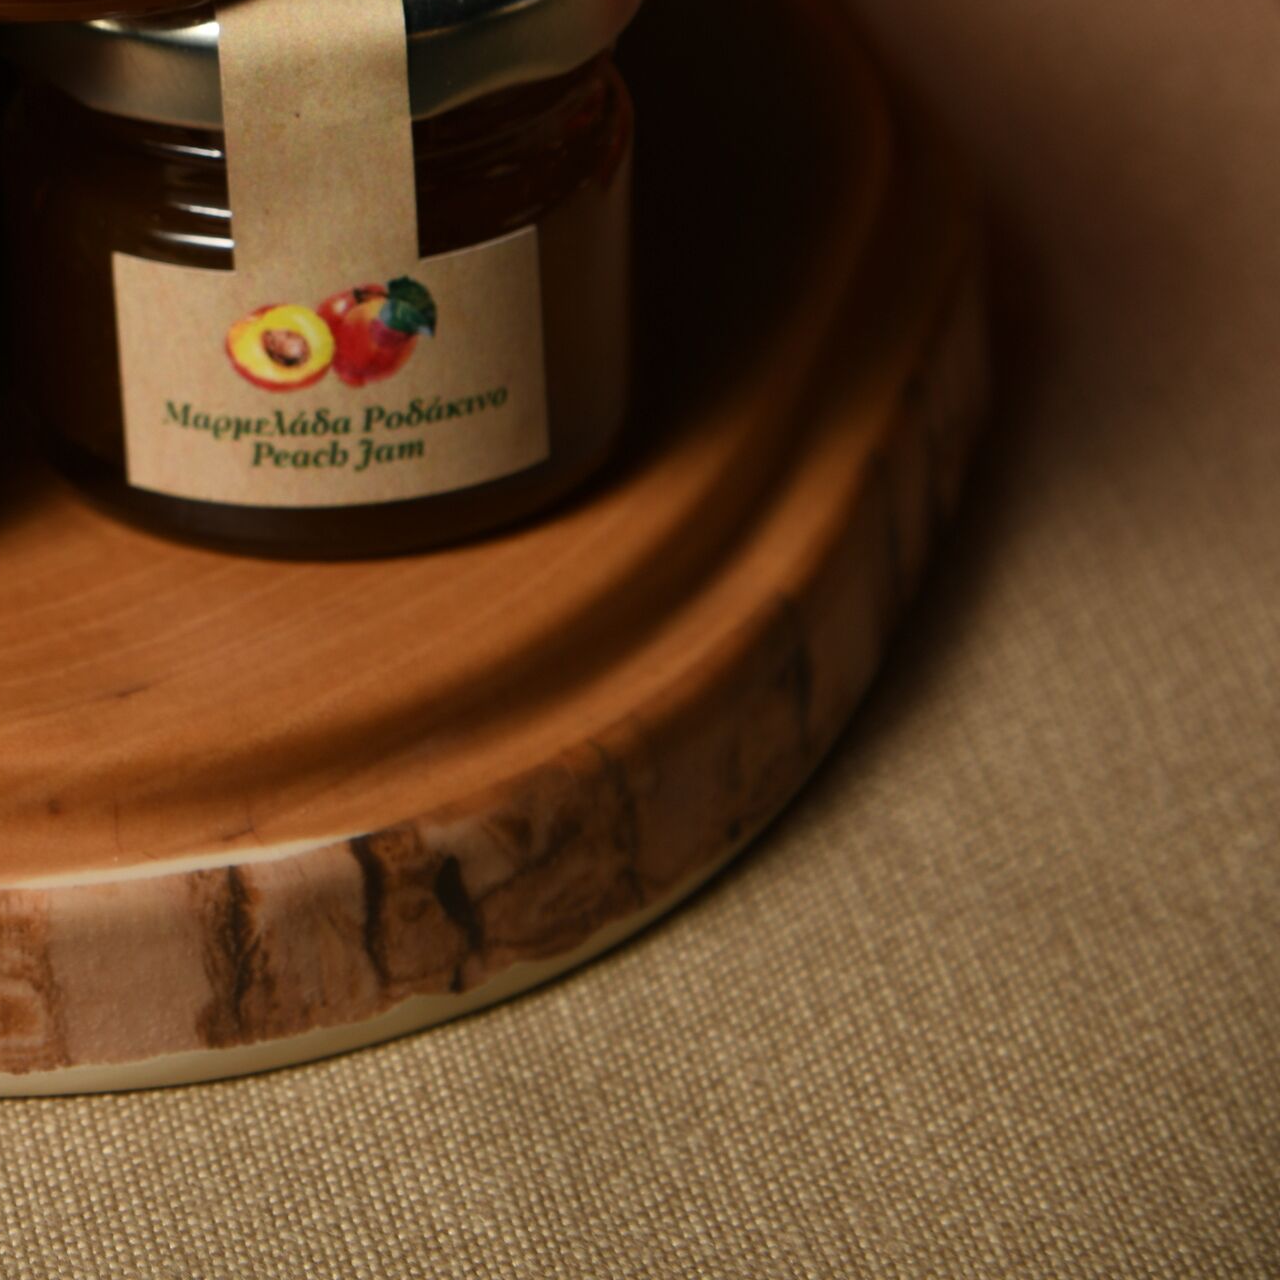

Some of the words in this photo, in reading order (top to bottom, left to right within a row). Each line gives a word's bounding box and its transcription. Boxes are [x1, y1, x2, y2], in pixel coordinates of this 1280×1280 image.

[161, 400, 352, 441] Μαρμελάδα
[360, 384, 510, 434] Ροδάκινο
[250, 439, 350, 470] Peach
[354, 437, 426, 472] Jam
